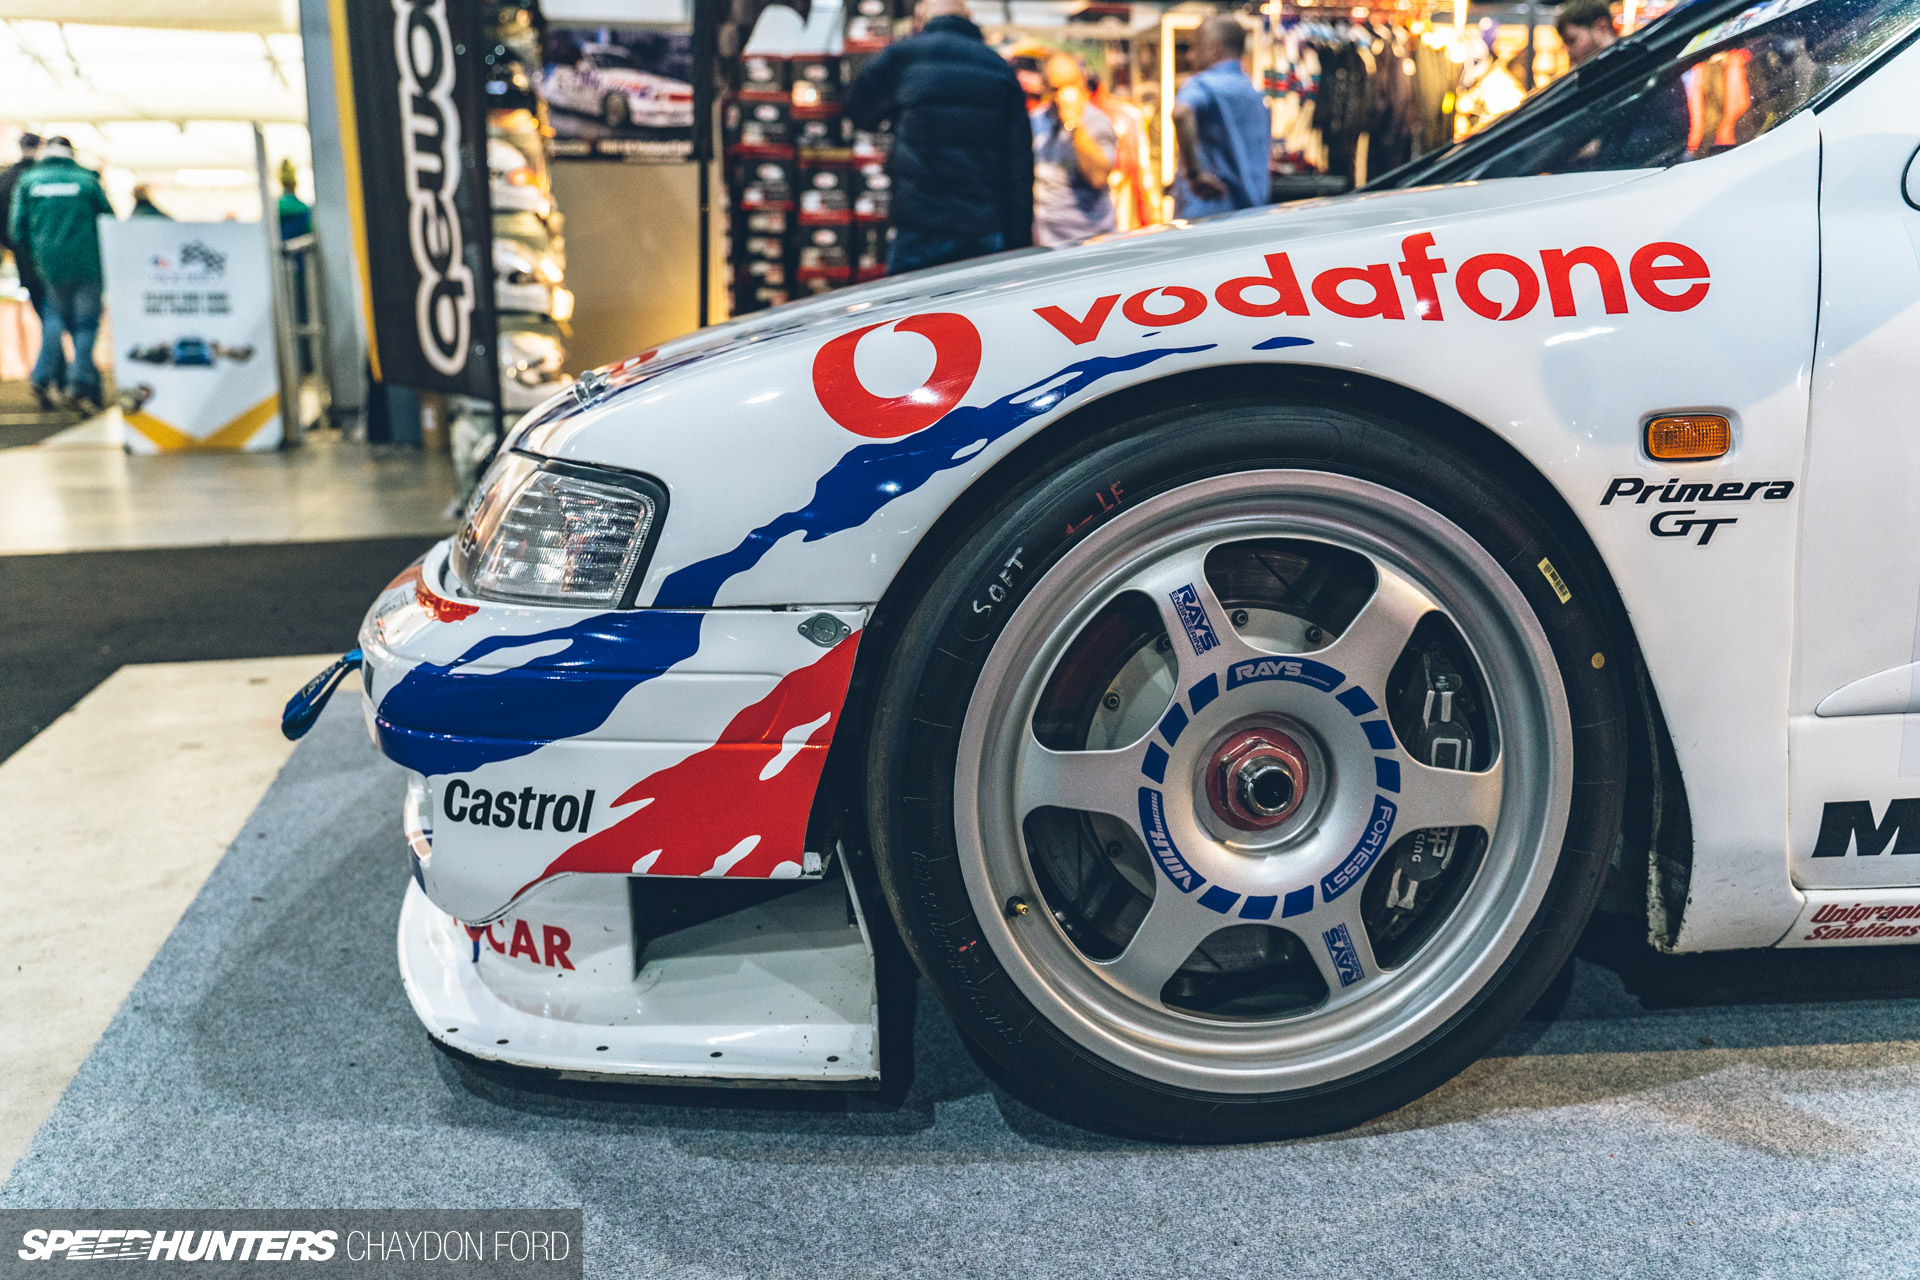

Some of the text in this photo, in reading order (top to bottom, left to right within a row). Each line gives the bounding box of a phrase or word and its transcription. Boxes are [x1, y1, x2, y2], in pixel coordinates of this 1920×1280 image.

[1032, 232, 1711, 346] vodafone
[1096, 481, 1124, 512] LF
[1600, 477, 1795, 506] Primera
[1650, 509, 1738, 546] GT
[972, 547, 1024, 618] SOFT
[1171, 590, 1205, 655] ENGINEERING
[1176, 584, 1218, 651] RAYS
[1235, 661, 1303, 681] RAYS
[443, 779, 596, 833] Castrol
[1411, 828, 1426, 863] CING
[1804, 922, 1920, 941] Solutions
[1324, 927, 1358, 987] RAYS
